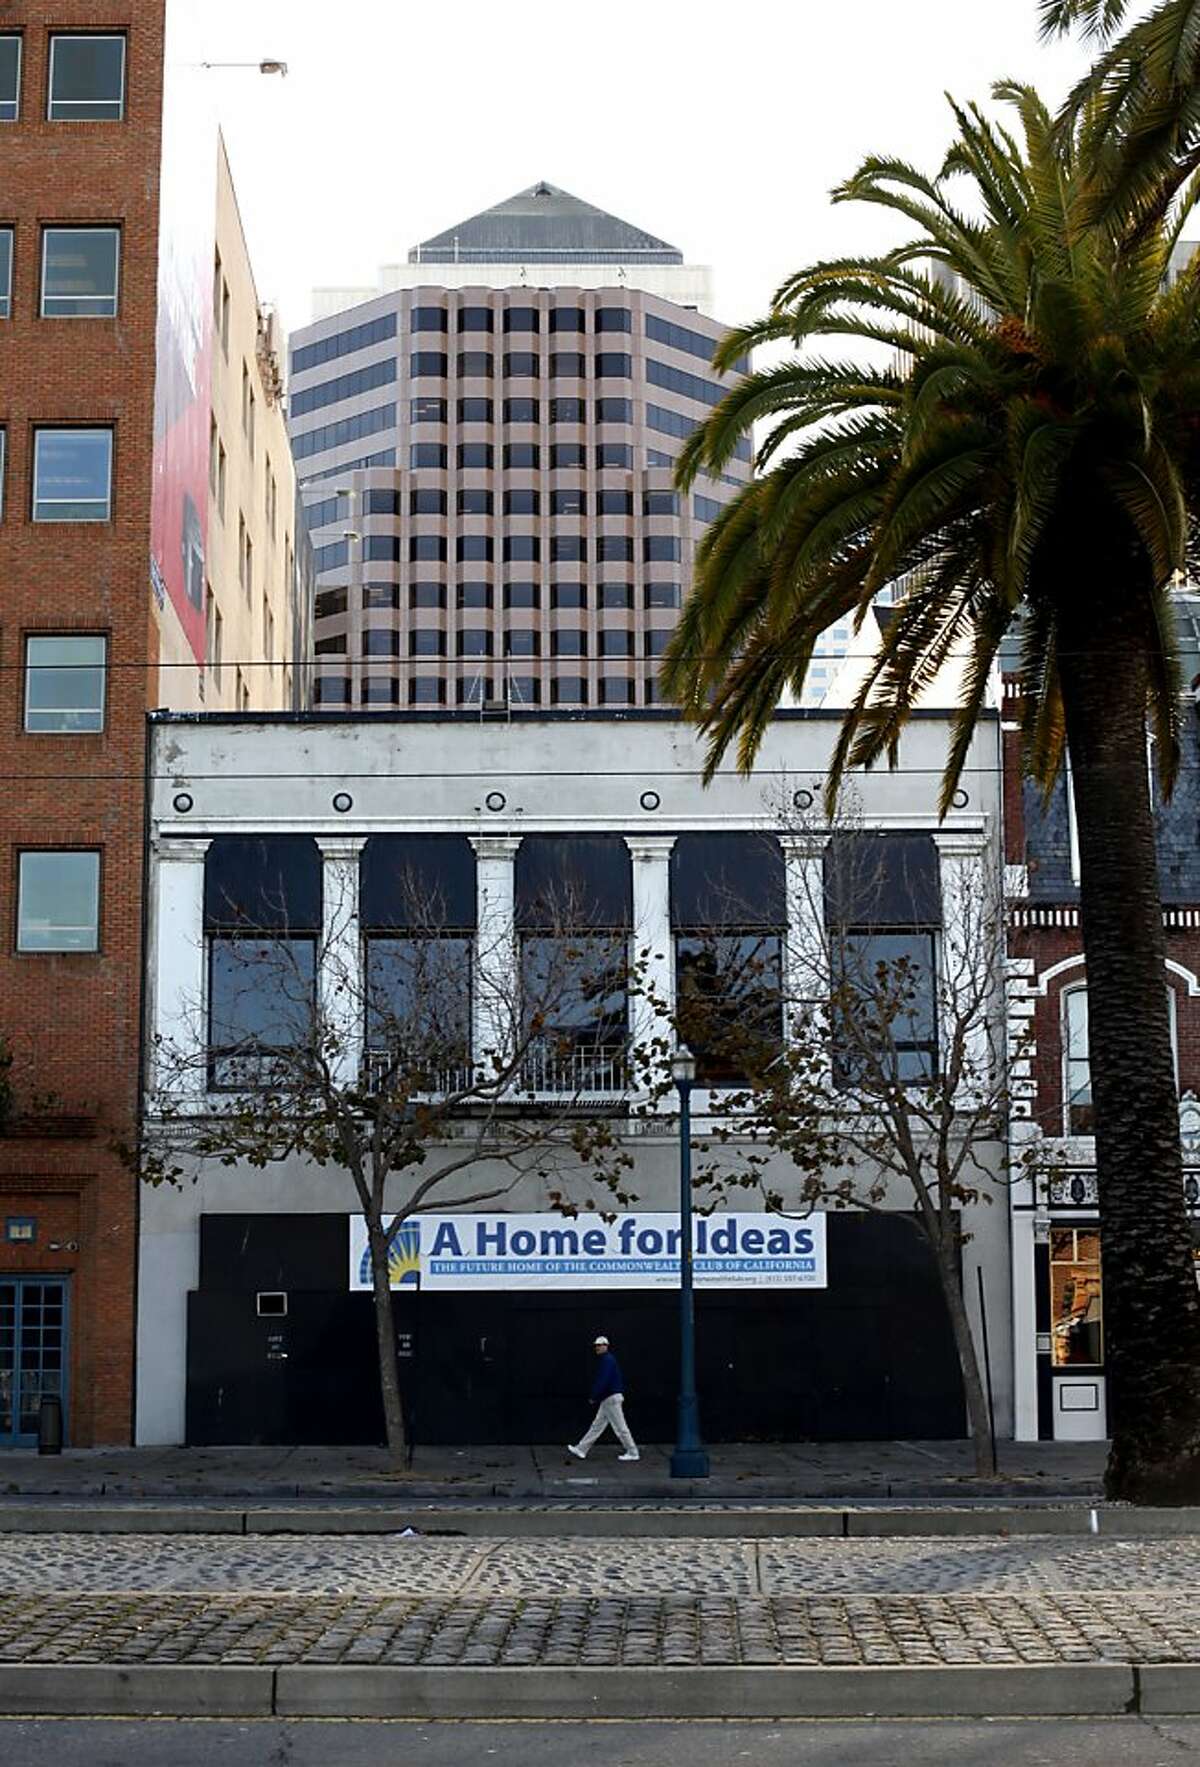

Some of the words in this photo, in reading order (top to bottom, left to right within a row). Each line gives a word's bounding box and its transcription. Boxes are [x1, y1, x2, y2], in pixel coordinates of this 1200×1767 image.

[429, 1221, 463, 1256] A
[476, 1221, 606, 1256] Home
[618, 1218, 682, 1255] for
[696, 1218, 814, 1255] Ideas
[432, 1262, 457, 1273] THE
[459, 1262, 504, 1273] FUTURE
[507, 1262, 544, 1273] HOME
[546, 1262, 561, 1273] OF
[563, 1262, 587, 1273] THE
[589, 1261, 682, 1272] COMMONWEALT
[693, 1261, 723, 1271] CLUB
[726, 1261, 742, 1271] OF
[743, 1261, 813, 1271] CALIFORNIA
